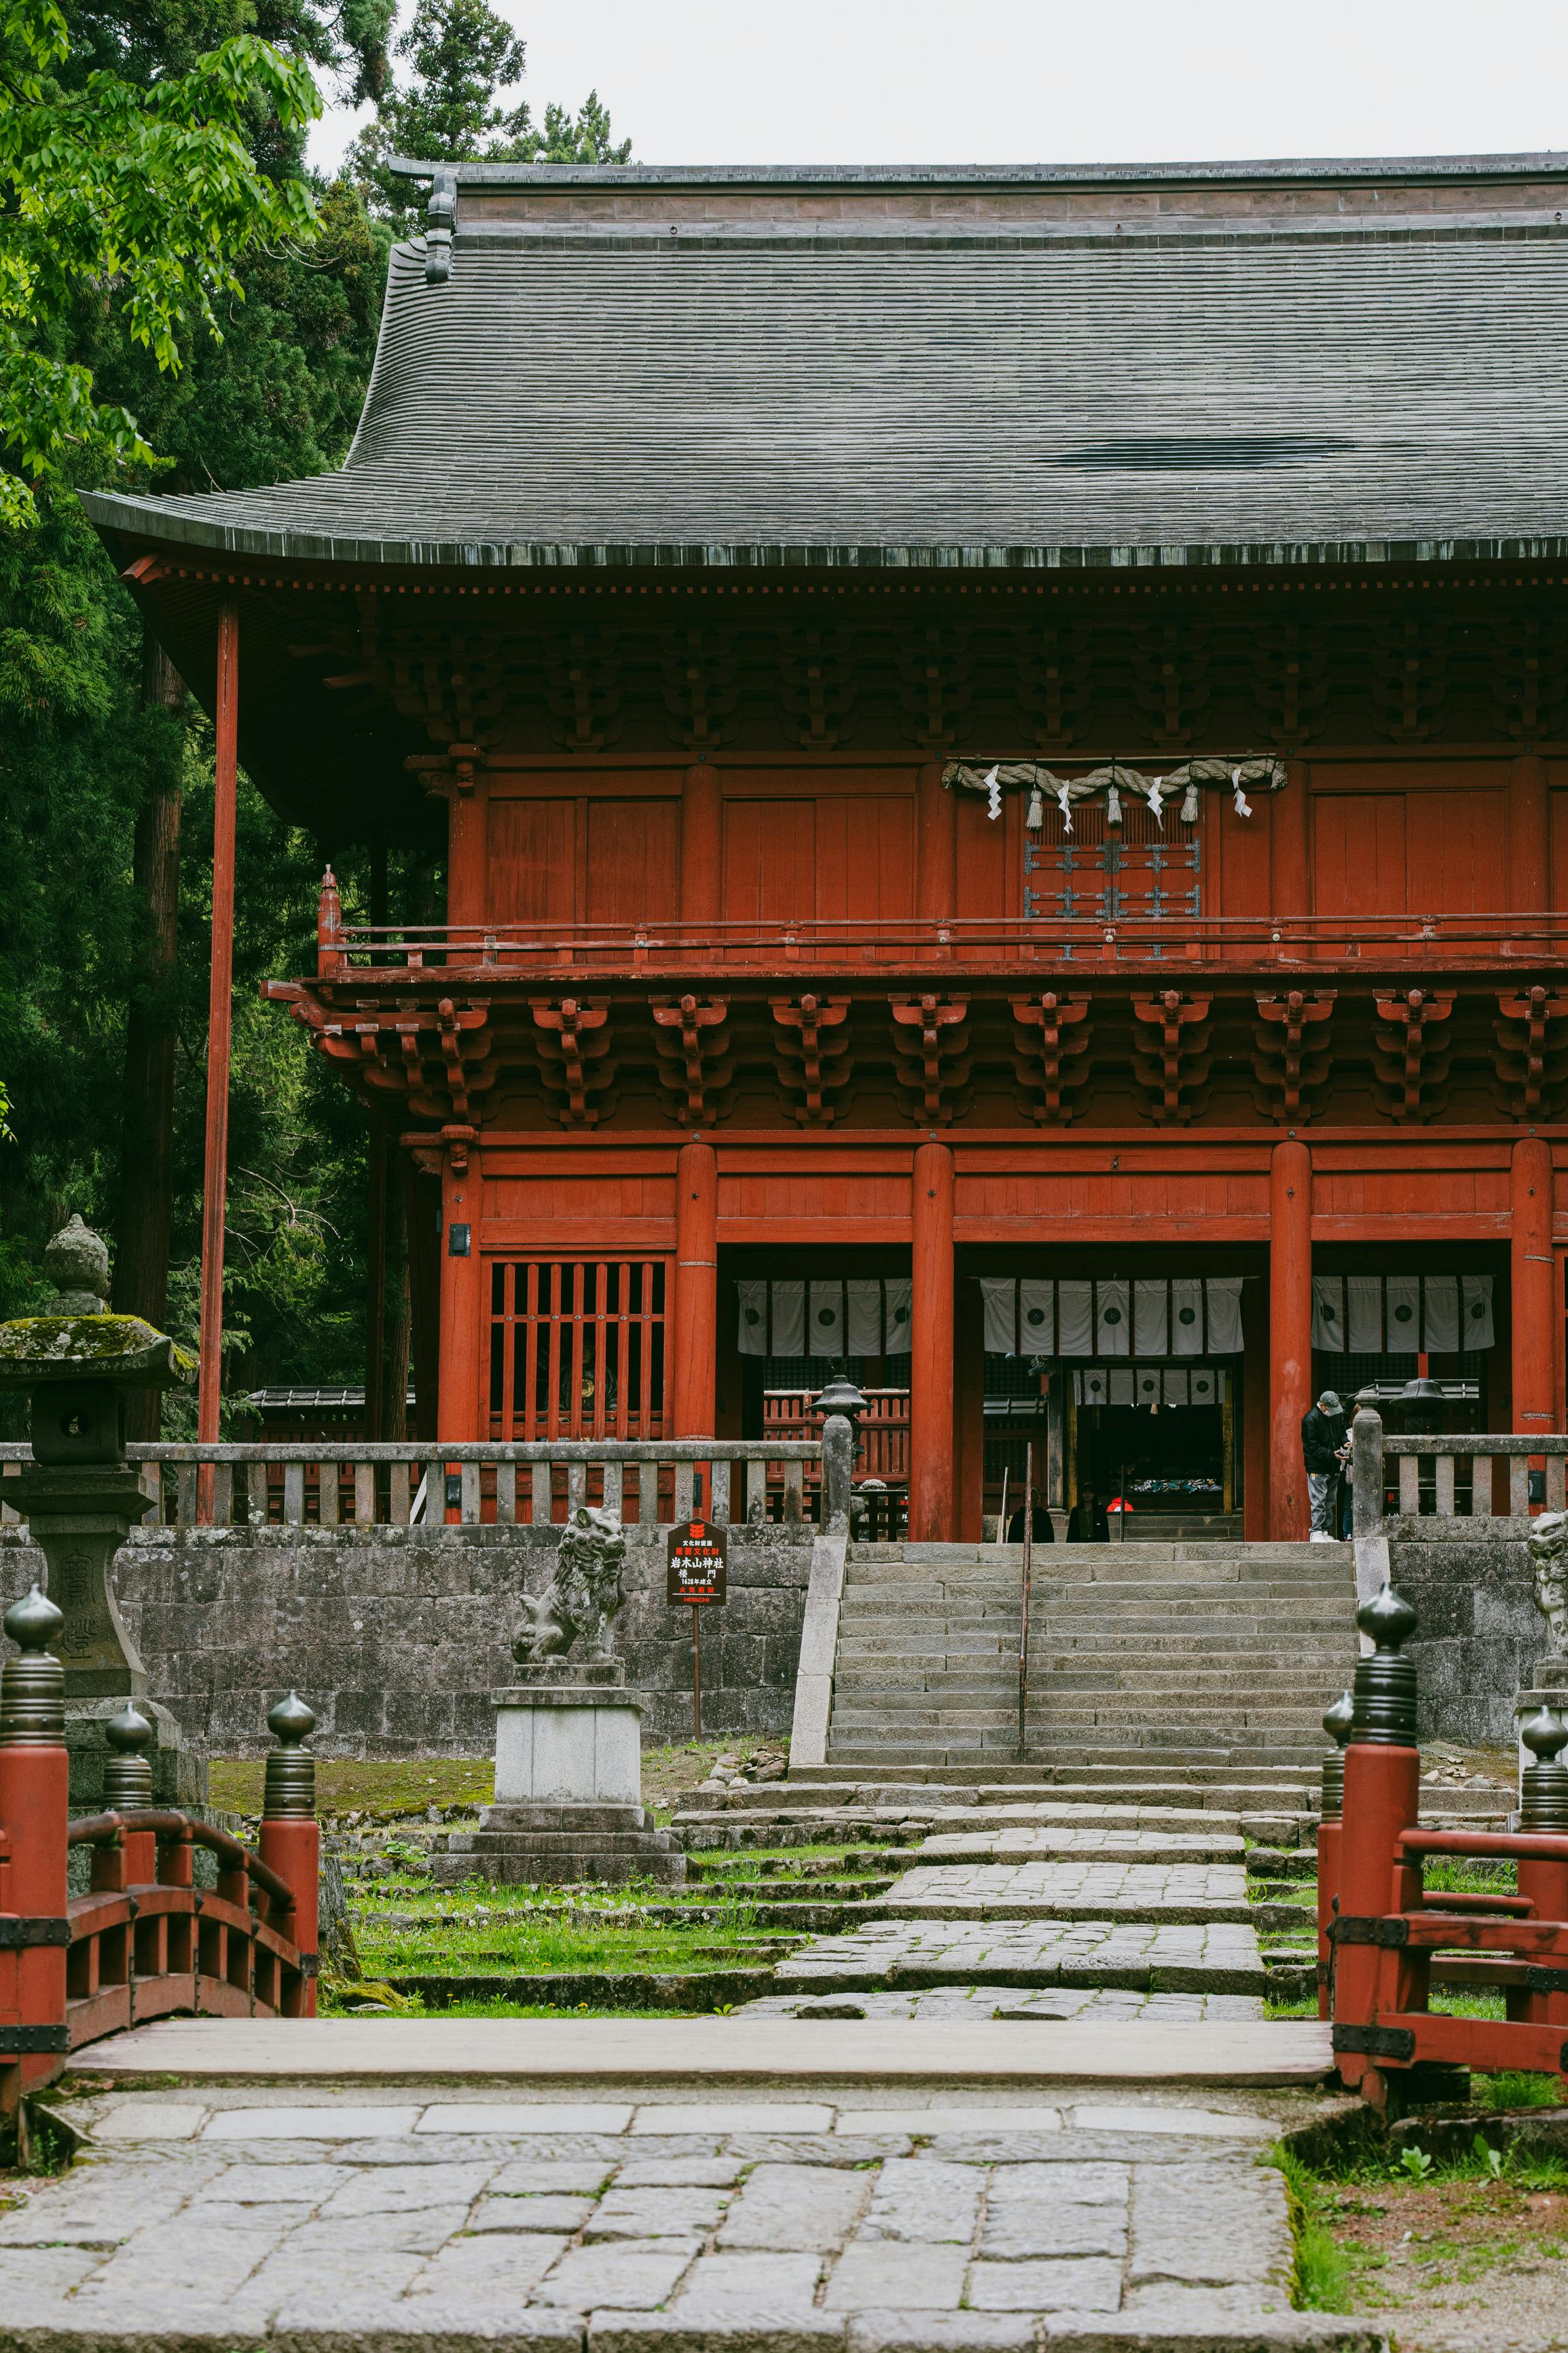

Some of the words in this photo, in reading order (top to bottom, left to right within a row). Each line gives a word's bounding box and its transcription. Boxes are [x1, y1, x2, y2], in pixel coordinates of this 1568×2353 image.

[676, 1547, 719, 1556] 重要文化財
[670, 1557, 724, 1568] 岩木山神社
